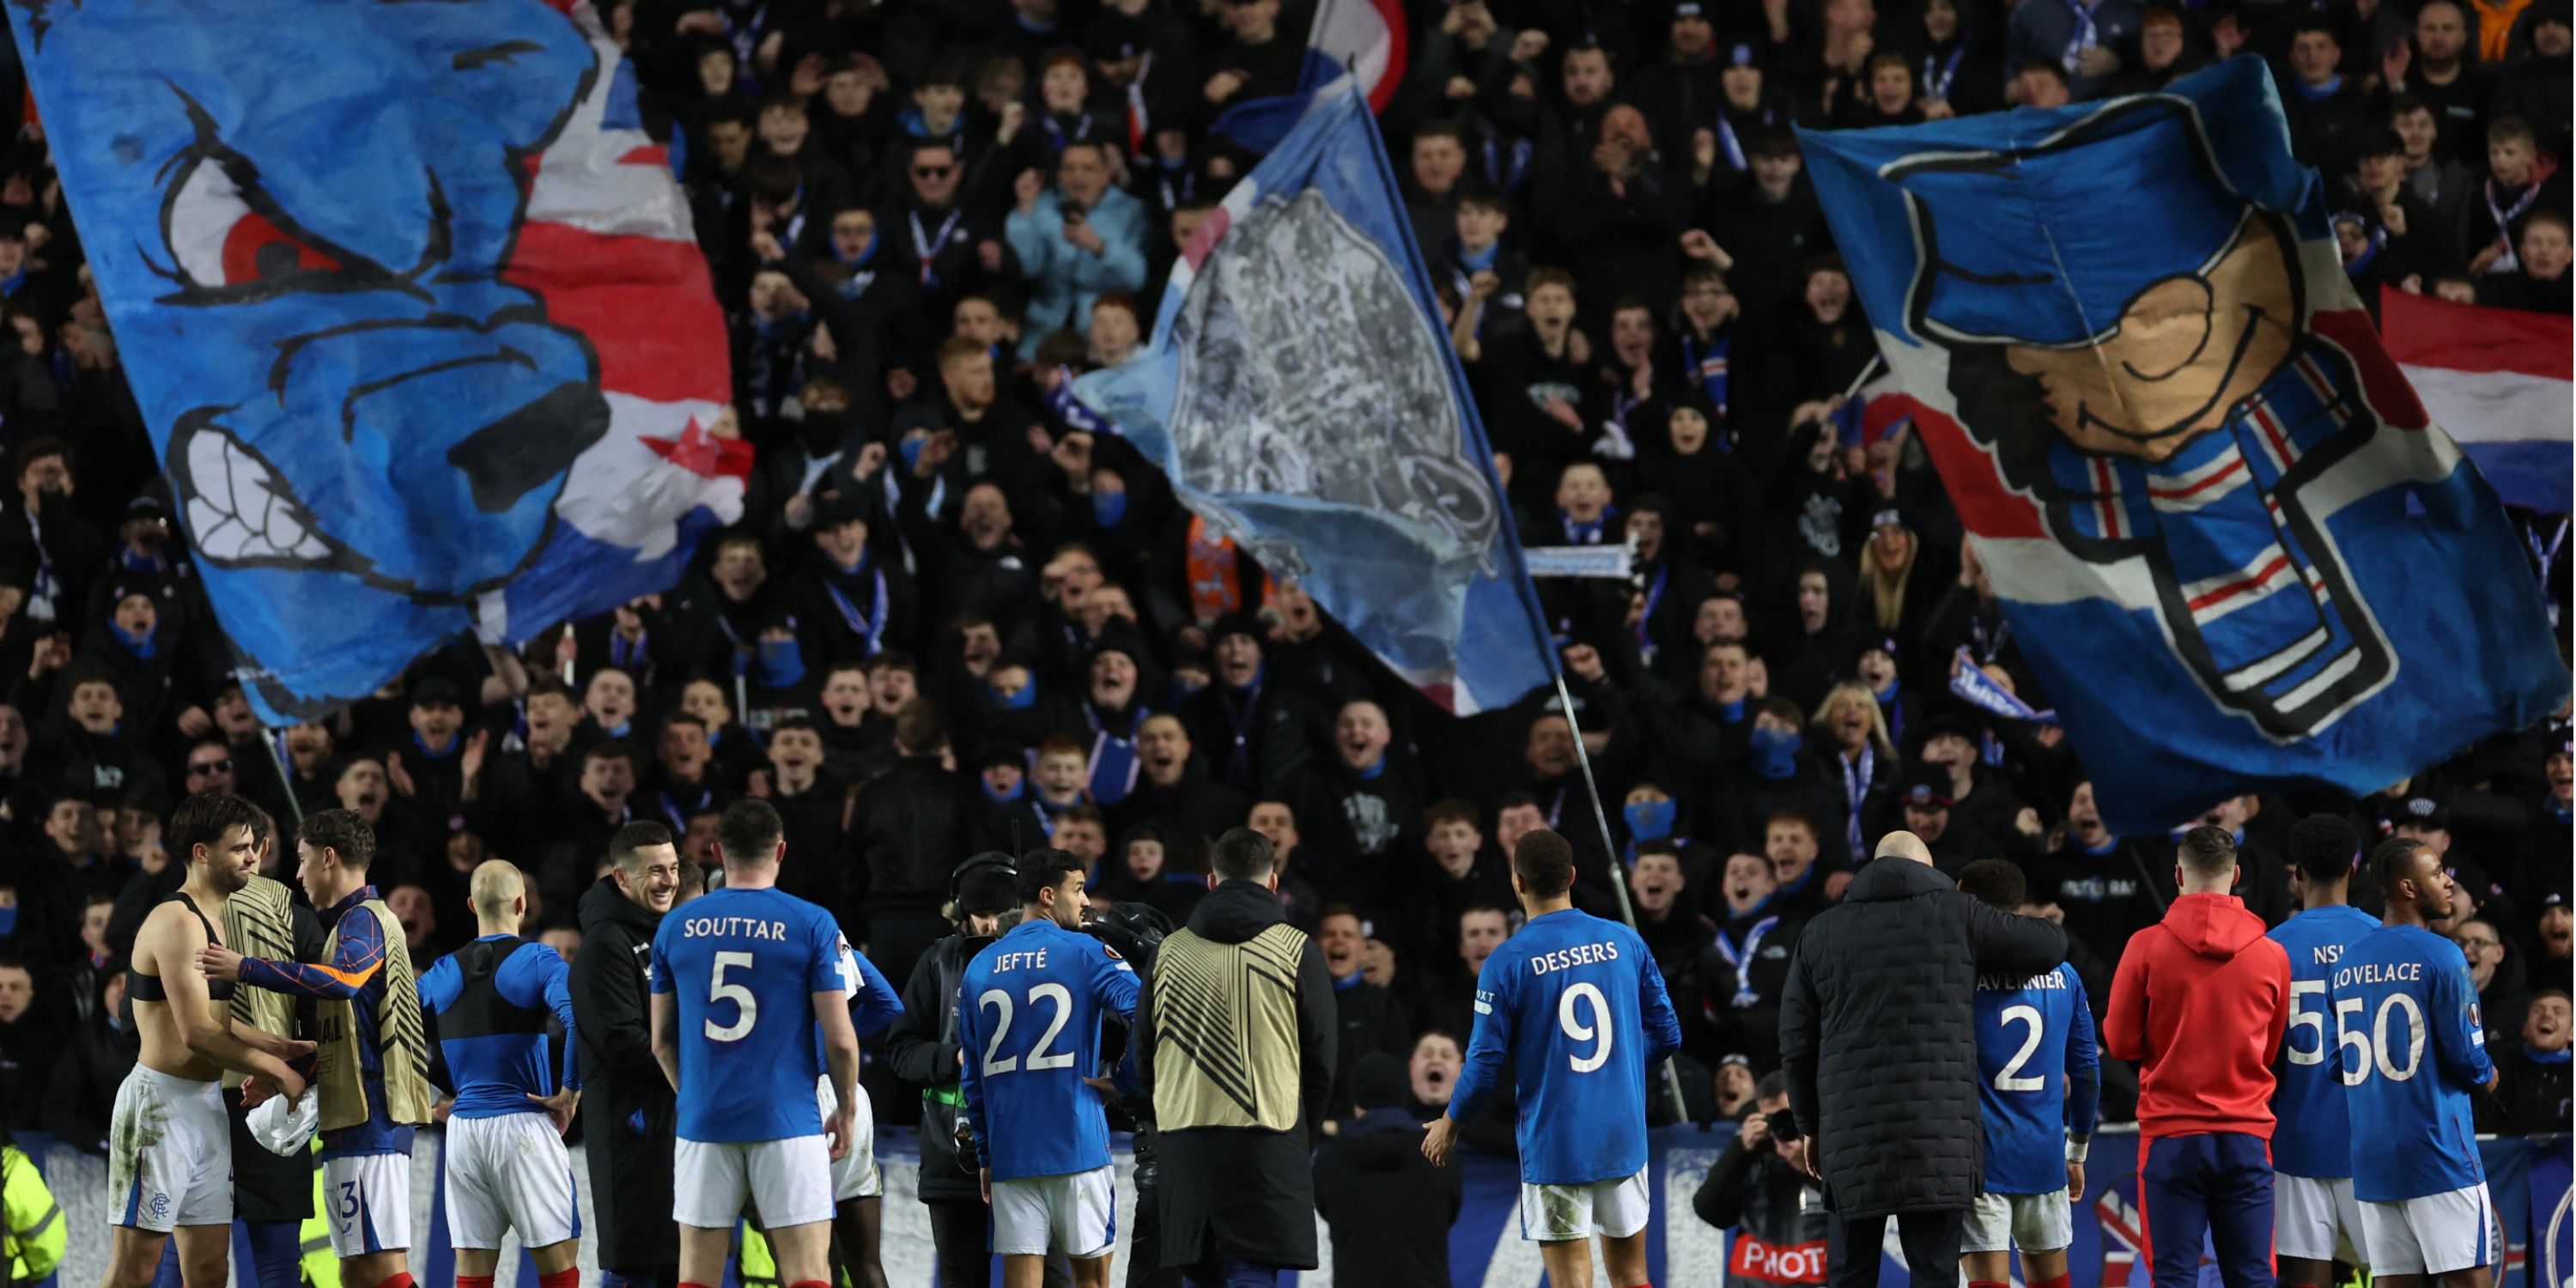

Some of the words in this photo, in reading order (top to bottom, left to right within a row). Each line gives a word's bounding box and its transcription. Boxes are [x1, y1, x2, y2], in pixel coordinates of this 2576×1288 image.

[683, 917, 786, 941] SOUTTAR
[993, 947, 1047, 973] JEFTÉ
[1531, 941, 1619, 975] DESSERS
[2333, 963, 2421, 989] LOVELACE
[705, 951, 756, 1042] 5
[978, 982, 1074, 1078] 22
[1558, 981, 1613, 1073] 9
[2336, 993, 2426, 1086] 50
[1994, 1005, 2044, 1091] 2
[337, 1181, 359, 1218] 3
[1743, 1242, 1827, 1278] PHOT
